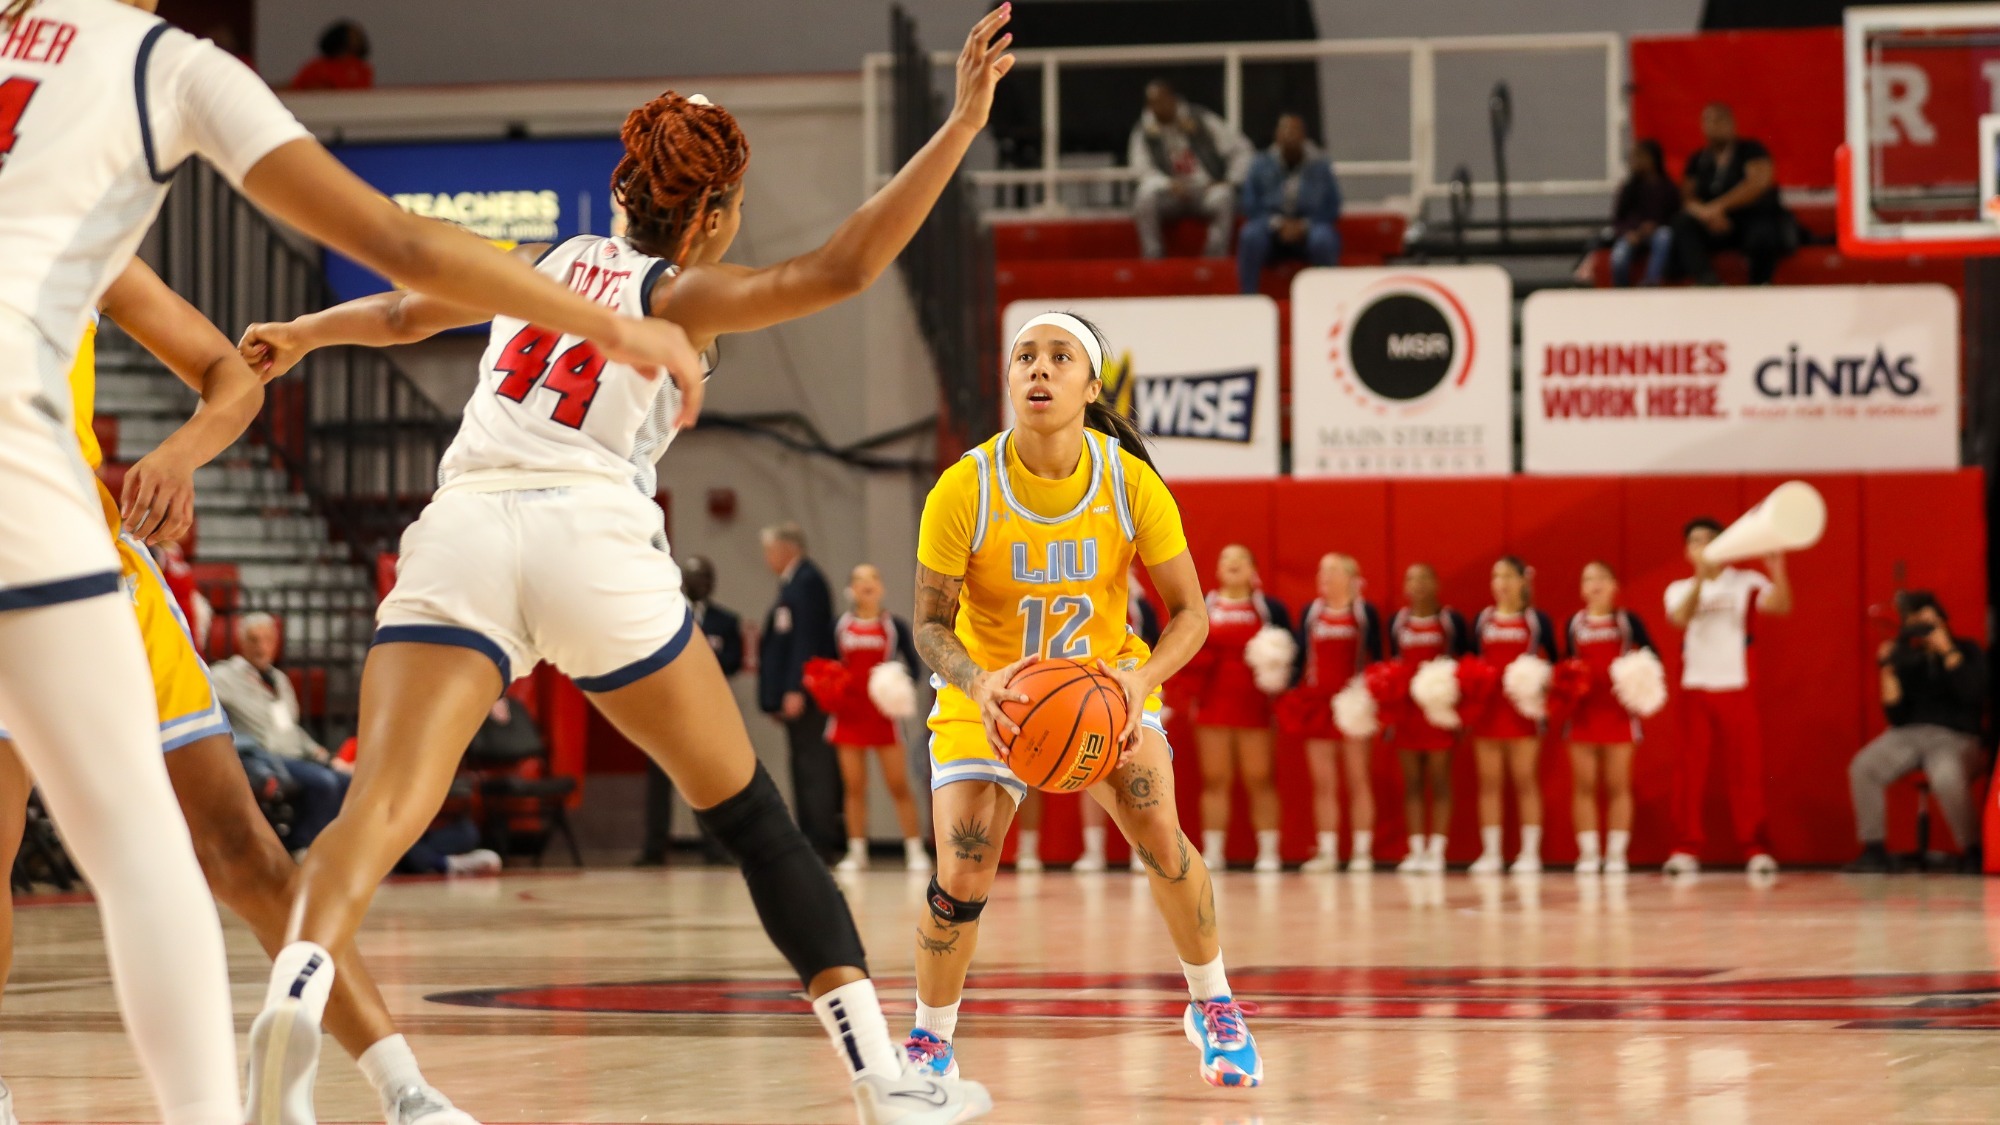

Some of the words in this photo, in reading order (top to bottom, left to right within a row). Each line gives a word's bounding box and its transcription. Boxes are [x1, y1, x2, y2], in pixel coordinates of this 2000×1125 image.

[0, 16, 78, 65] HER
[1386, 332, 1450, 361] MSR
[1542, 342, 1728, 376] JOHNNIES
[493, 324, 607, 431] 44
[1134, 375, 1251, 440] WISE
[1541, 385, 1639, 419] WORK
[1645, 385, 1728, 418] HERE.
[1317, 425, 1386, 447] MAIN
[1392, 422, 1485, 446] STREET
[1093, 505, 1111, 514] NEC
[1012, 538, 1098, 584] LIU
[1016, 593, 1095, 660] 12
